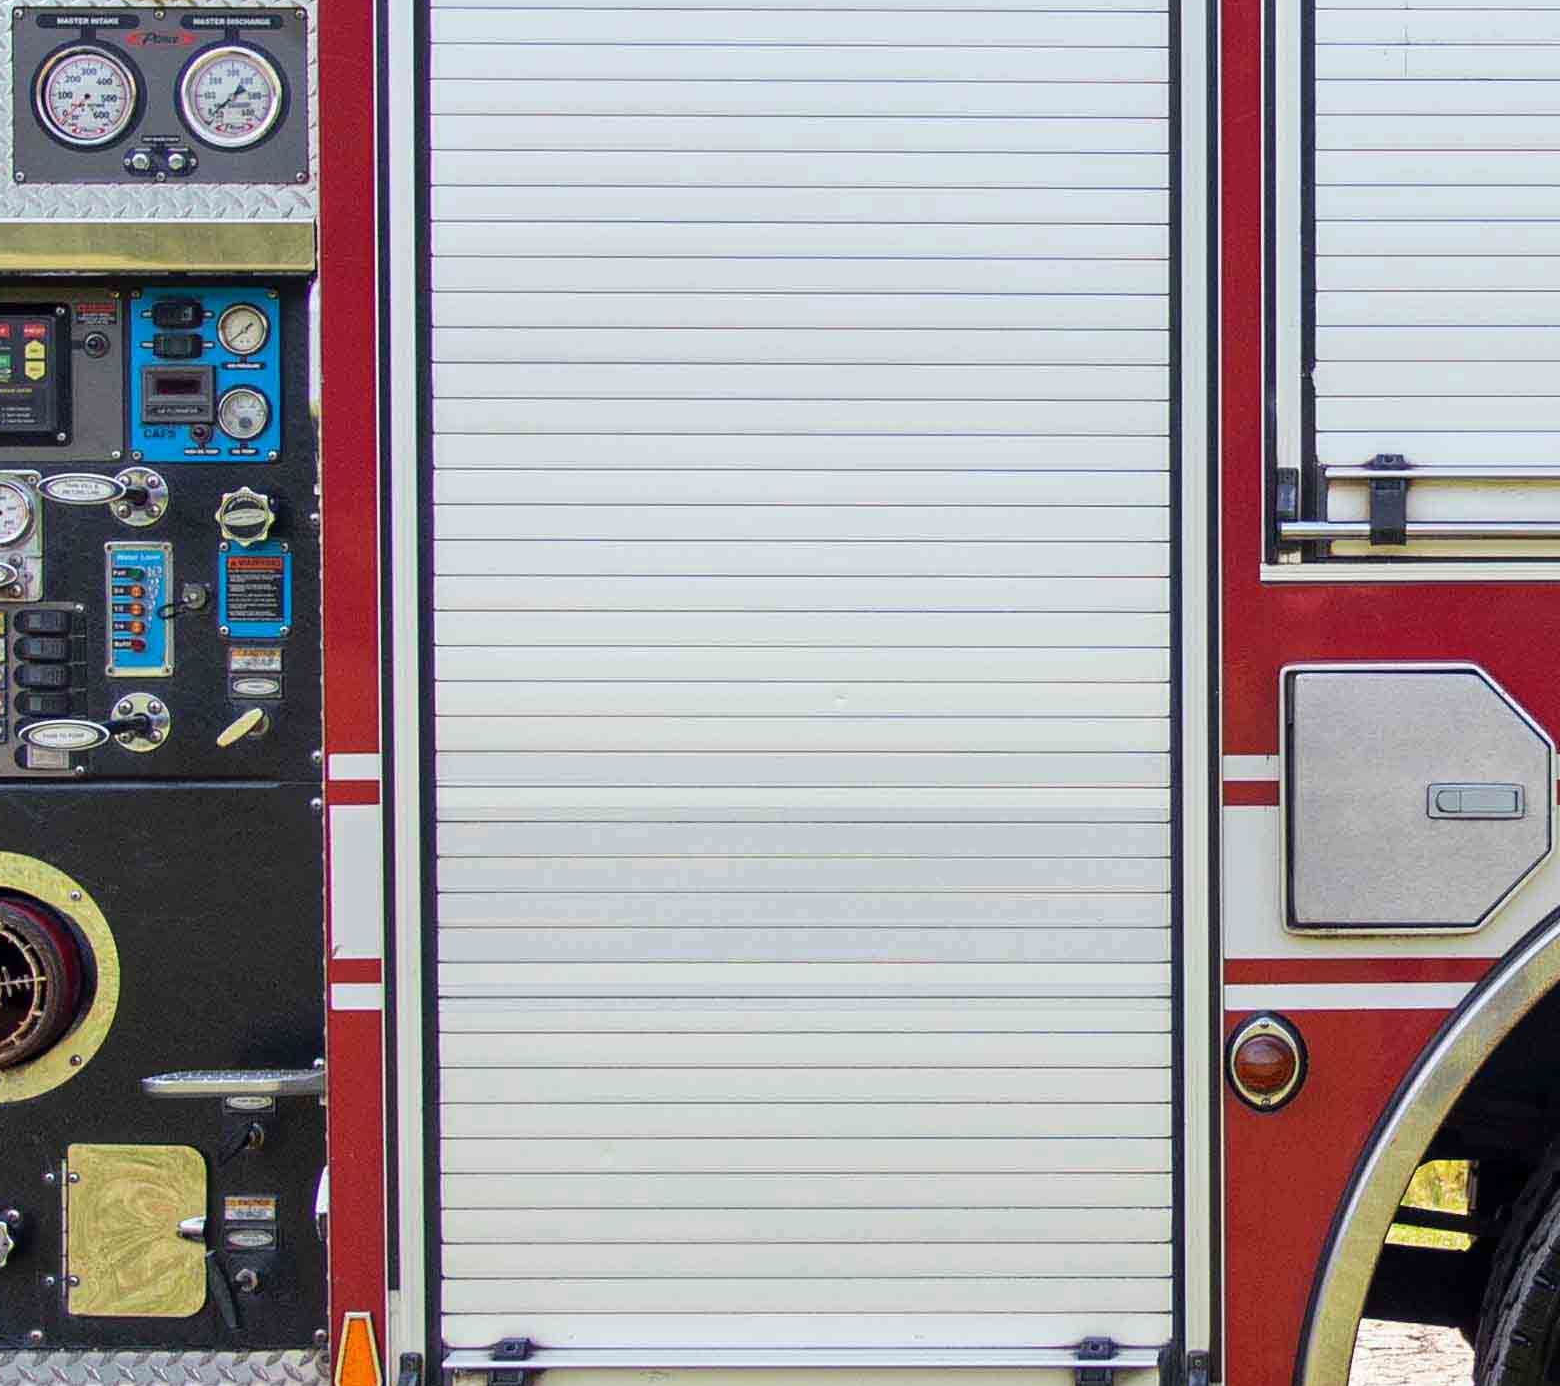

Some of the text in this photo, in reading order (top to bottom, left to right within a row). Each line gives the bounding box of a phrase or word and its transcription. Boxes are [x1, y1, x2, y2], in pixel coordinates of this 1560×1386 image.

[57, 17, 119, 25] MASTER INTAKE
[58, 92, 72, 100] 100
